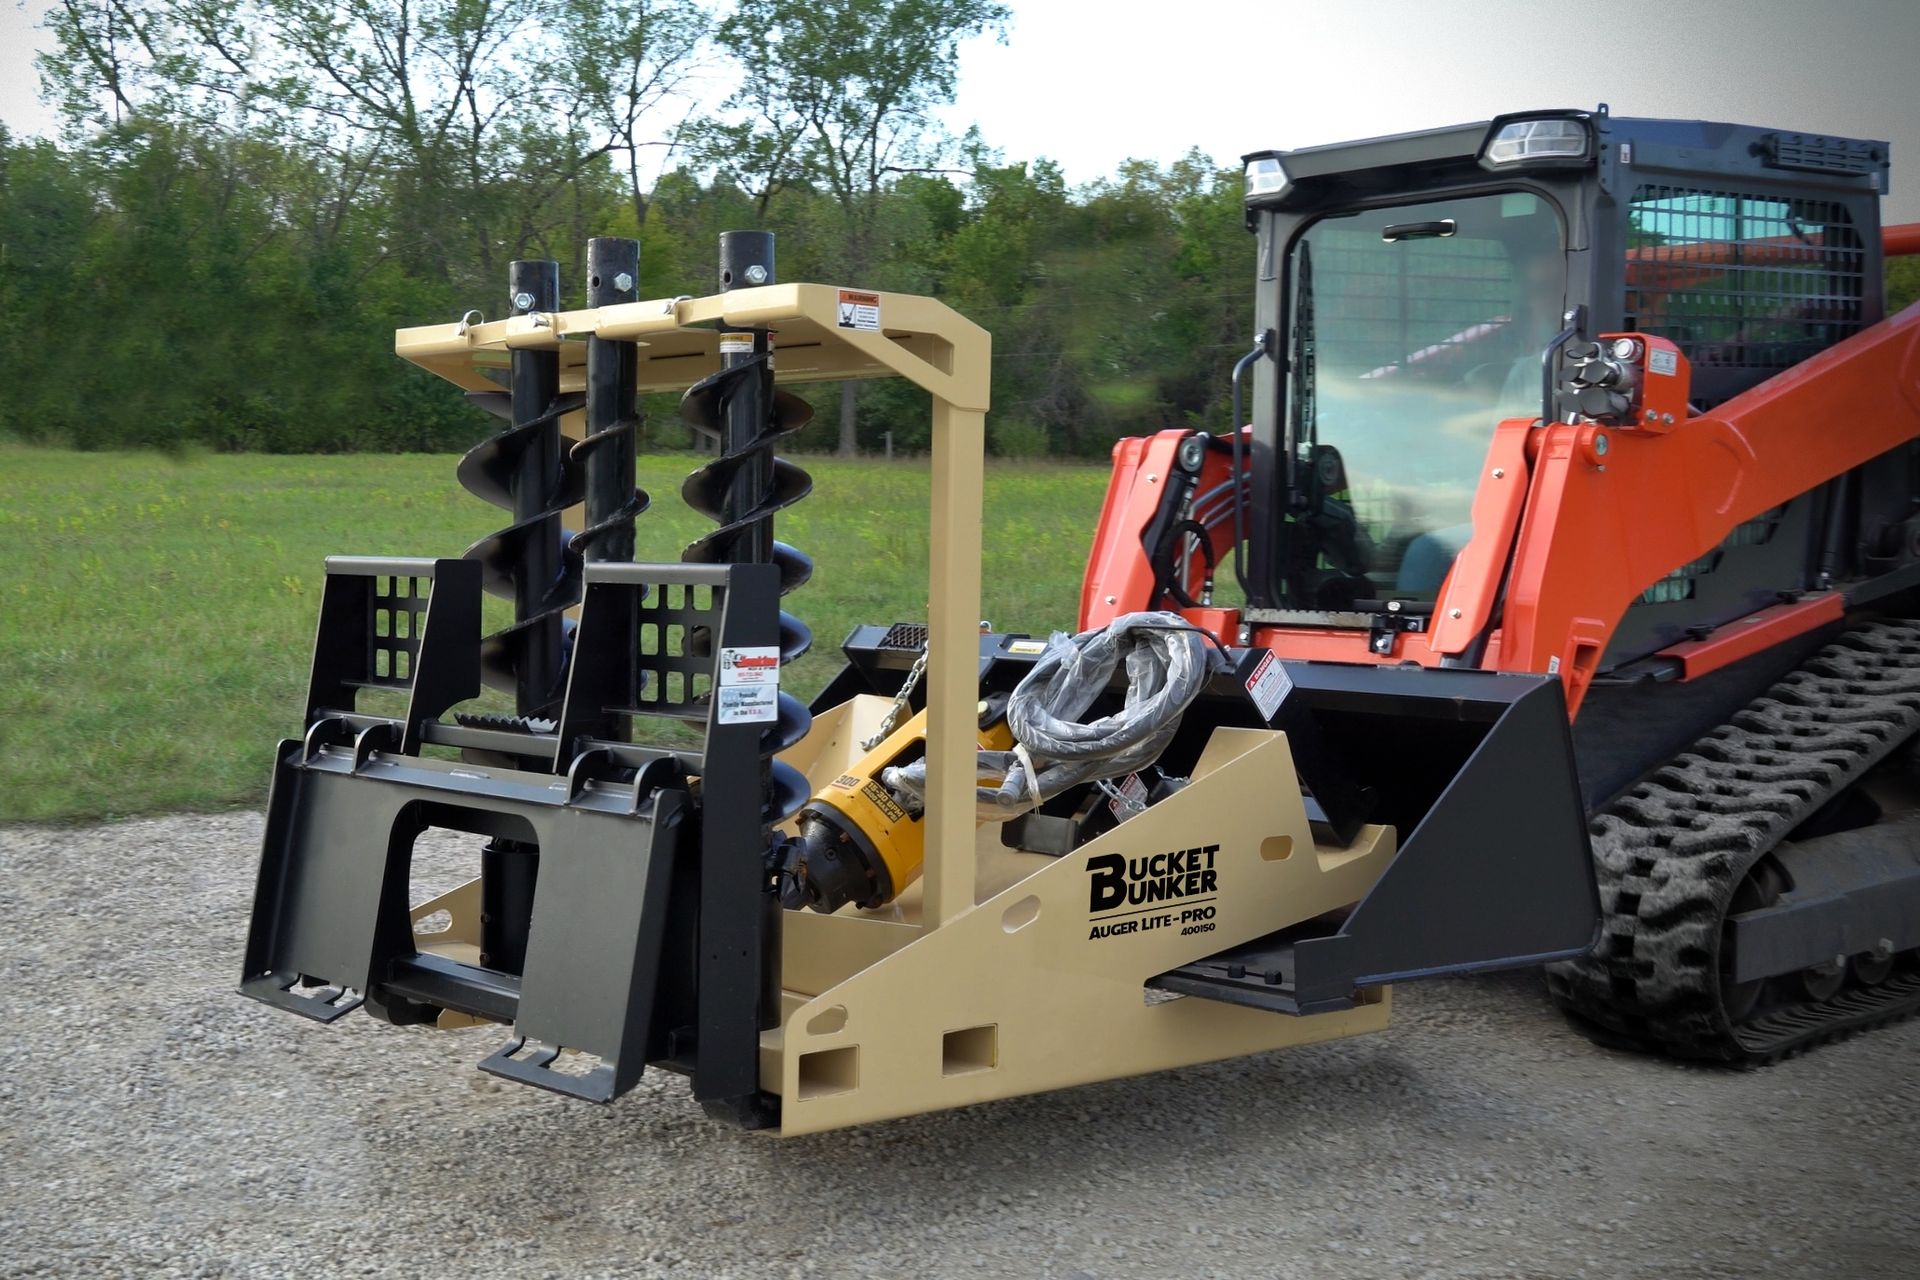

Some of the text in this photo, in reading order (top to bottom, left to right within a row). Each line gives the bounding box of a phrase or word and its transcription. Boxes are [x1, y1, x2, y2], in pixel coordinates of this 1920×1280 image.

[1254, 653, 1273, 680] DANGER
[876, 800, 890, 813] MAX
[887, 801, 904, 817] GPM
[1086, 844, 1220, 894] BUCKET
[1089, 868, 1218, 912] BUNKER
[1089, 921, 1138, 940] AUGER
[1181, 923, 1216, 936] 400150
